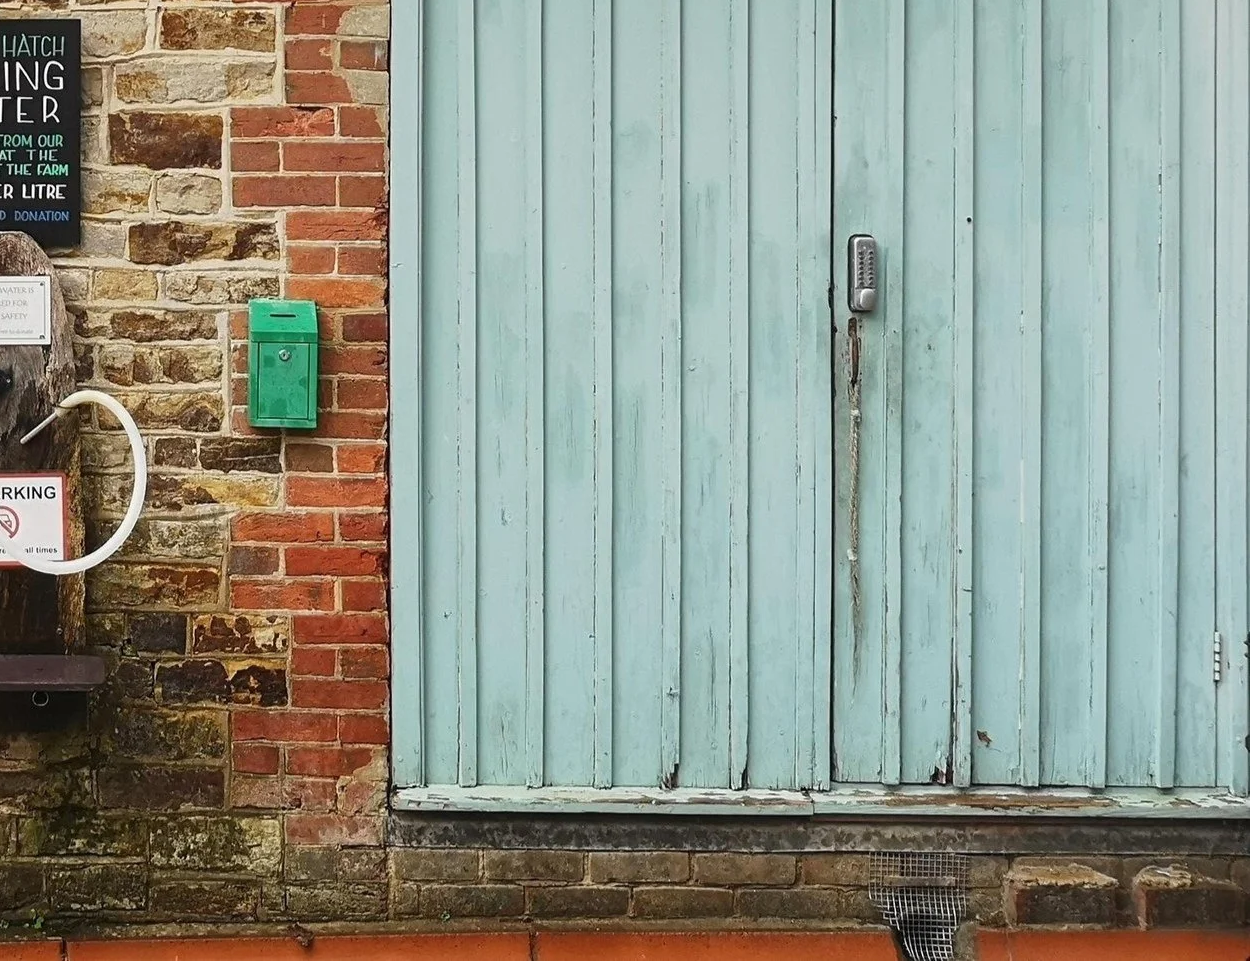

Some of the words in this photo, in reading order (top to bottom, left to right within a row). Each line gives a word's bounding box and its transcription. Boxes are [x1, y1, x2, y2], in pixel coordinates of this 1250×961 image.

[2, 34, 65, 58] HATCH
[37, 134, 64, 148] OUR
[26, 149, 58, 161] THE
[6, 163, 32, 176] THE
[37, 163, 69, 176] FARM
[21, 183, 67, 200] LITRE
[14, 210, 70, 222] DONATION
[0, 286, 27, 294] WATER
[12, 299, 28, 307] FOR
[1, 312, 28, 320] SAFETY
[36, 546, 58, 554] times
